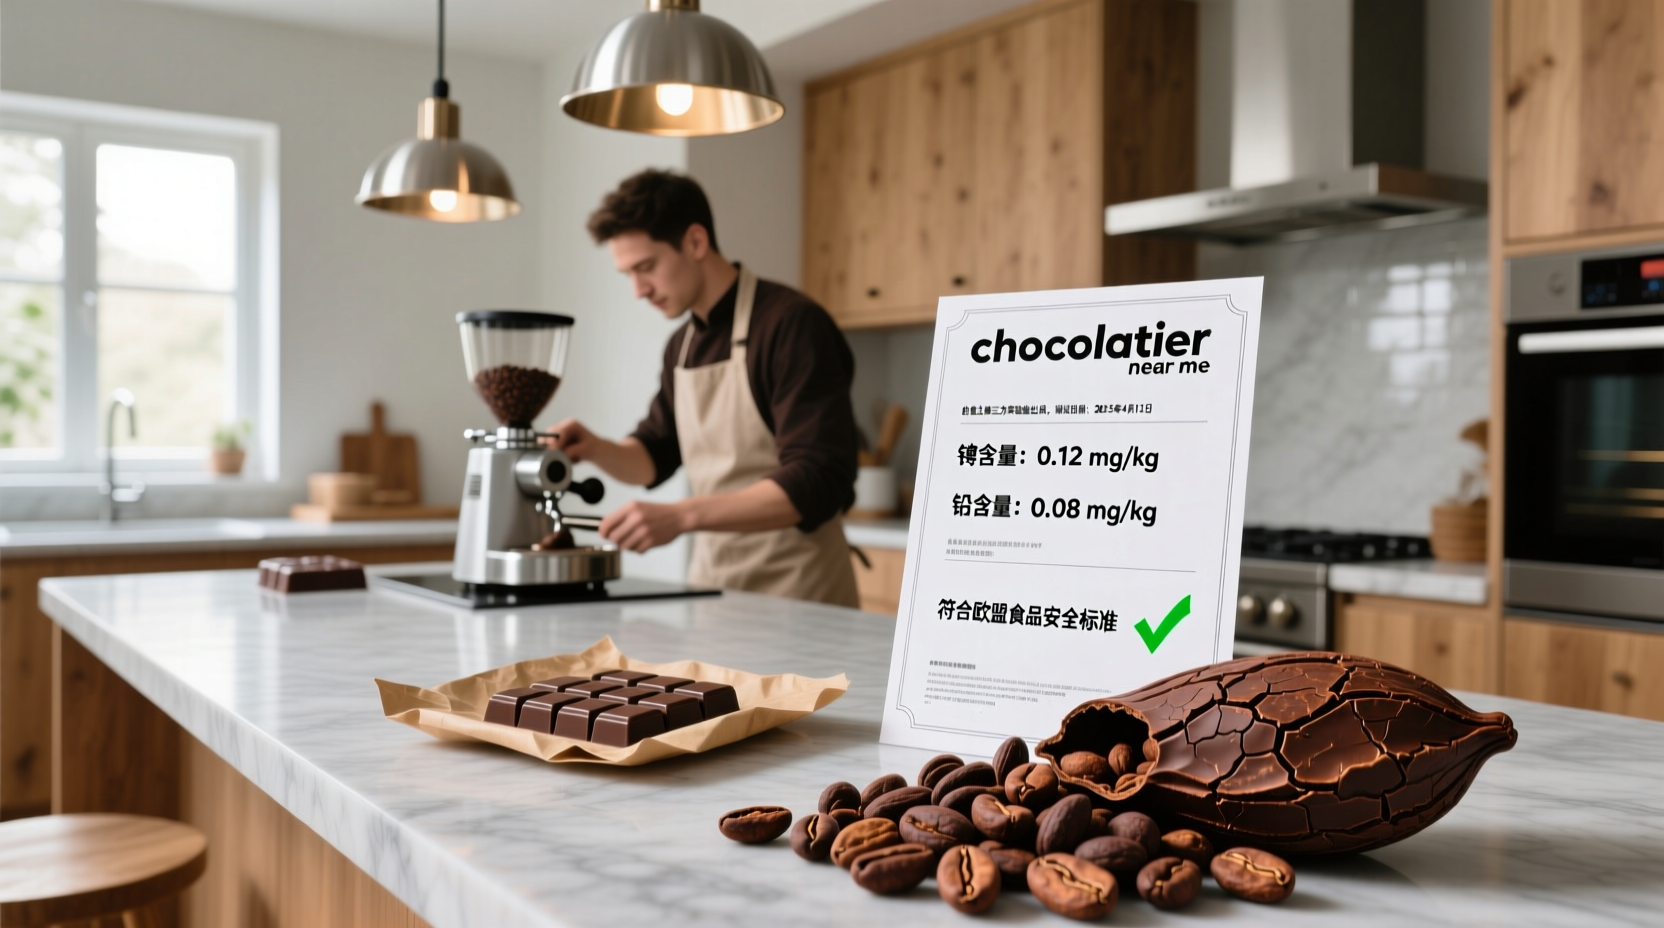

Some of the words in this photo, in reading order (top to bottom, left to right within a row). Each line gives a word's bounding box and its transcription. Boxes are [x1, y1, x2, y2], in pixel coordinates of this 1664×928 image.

[970, 320, 1212, 364] chocolatier
[1128, 361, 1175, 376] near
[1179, 360, 1211, 374] me
[1037, 445, 1083, 466] 0.12
[1088, 445, 1159, 473] mg/kg
[1030, 497, 1081, 519] 0.08
[1086, 499, 1157, 528] mg/kg
[937, 598, 1119, 633] 符合欧盟食品安全标准
